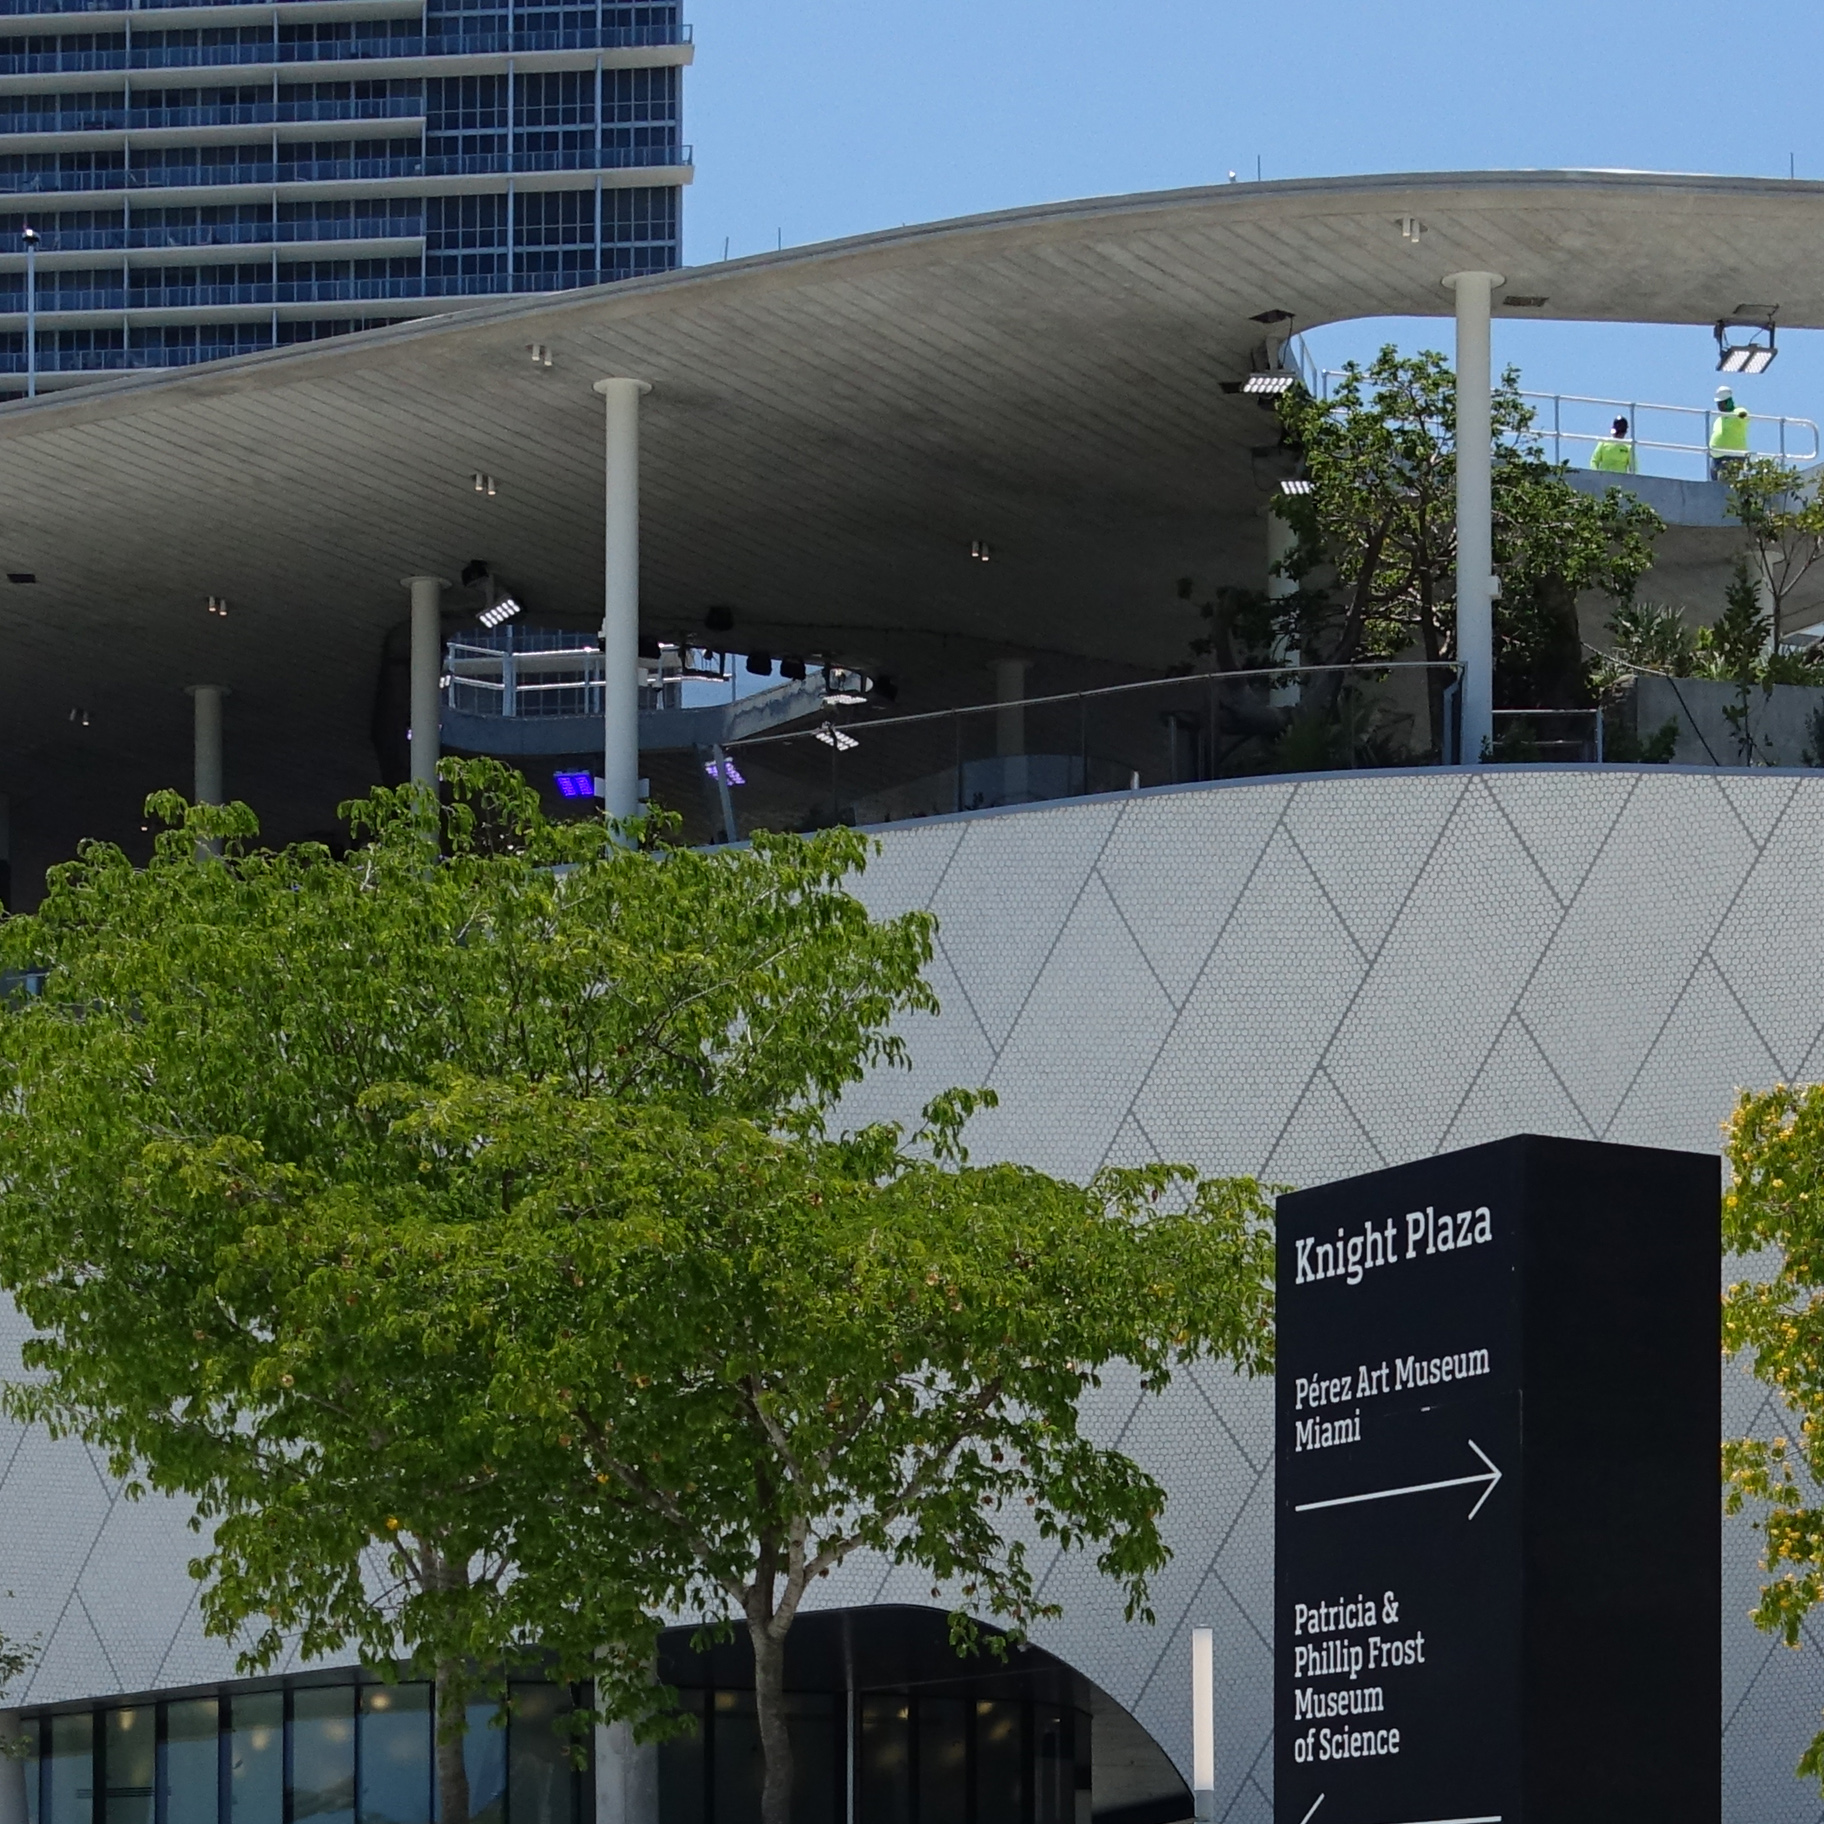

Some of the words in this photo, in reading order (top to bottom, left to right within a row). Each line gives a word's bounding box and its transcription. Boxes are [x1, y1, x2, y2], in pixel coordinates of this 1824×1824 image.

[1296, 1218, 1397, 1285] Knight
[1406, 1205, 1492, 1259] Plaza
[1296, 1373, 1351, 1409] Pérez
[1356, 1361, 1389, 1397] Art
[1395, 1347, 1490, 1390] Museum
[1296, 1408, 1360, 1452] Miami
[1295, 1594, 1376, 1635] Patricia
[1382, 1591, 1398, 1624] &
[1295, 1639, 1362, 1679] Phillip
[1368, 1631, 1425, 1668] Frost
[1295, 1687, 1384, 1720] Museum
[1295, 1728, 1316, 1763] of
[1320, 1725, 1399, 1760] Science
